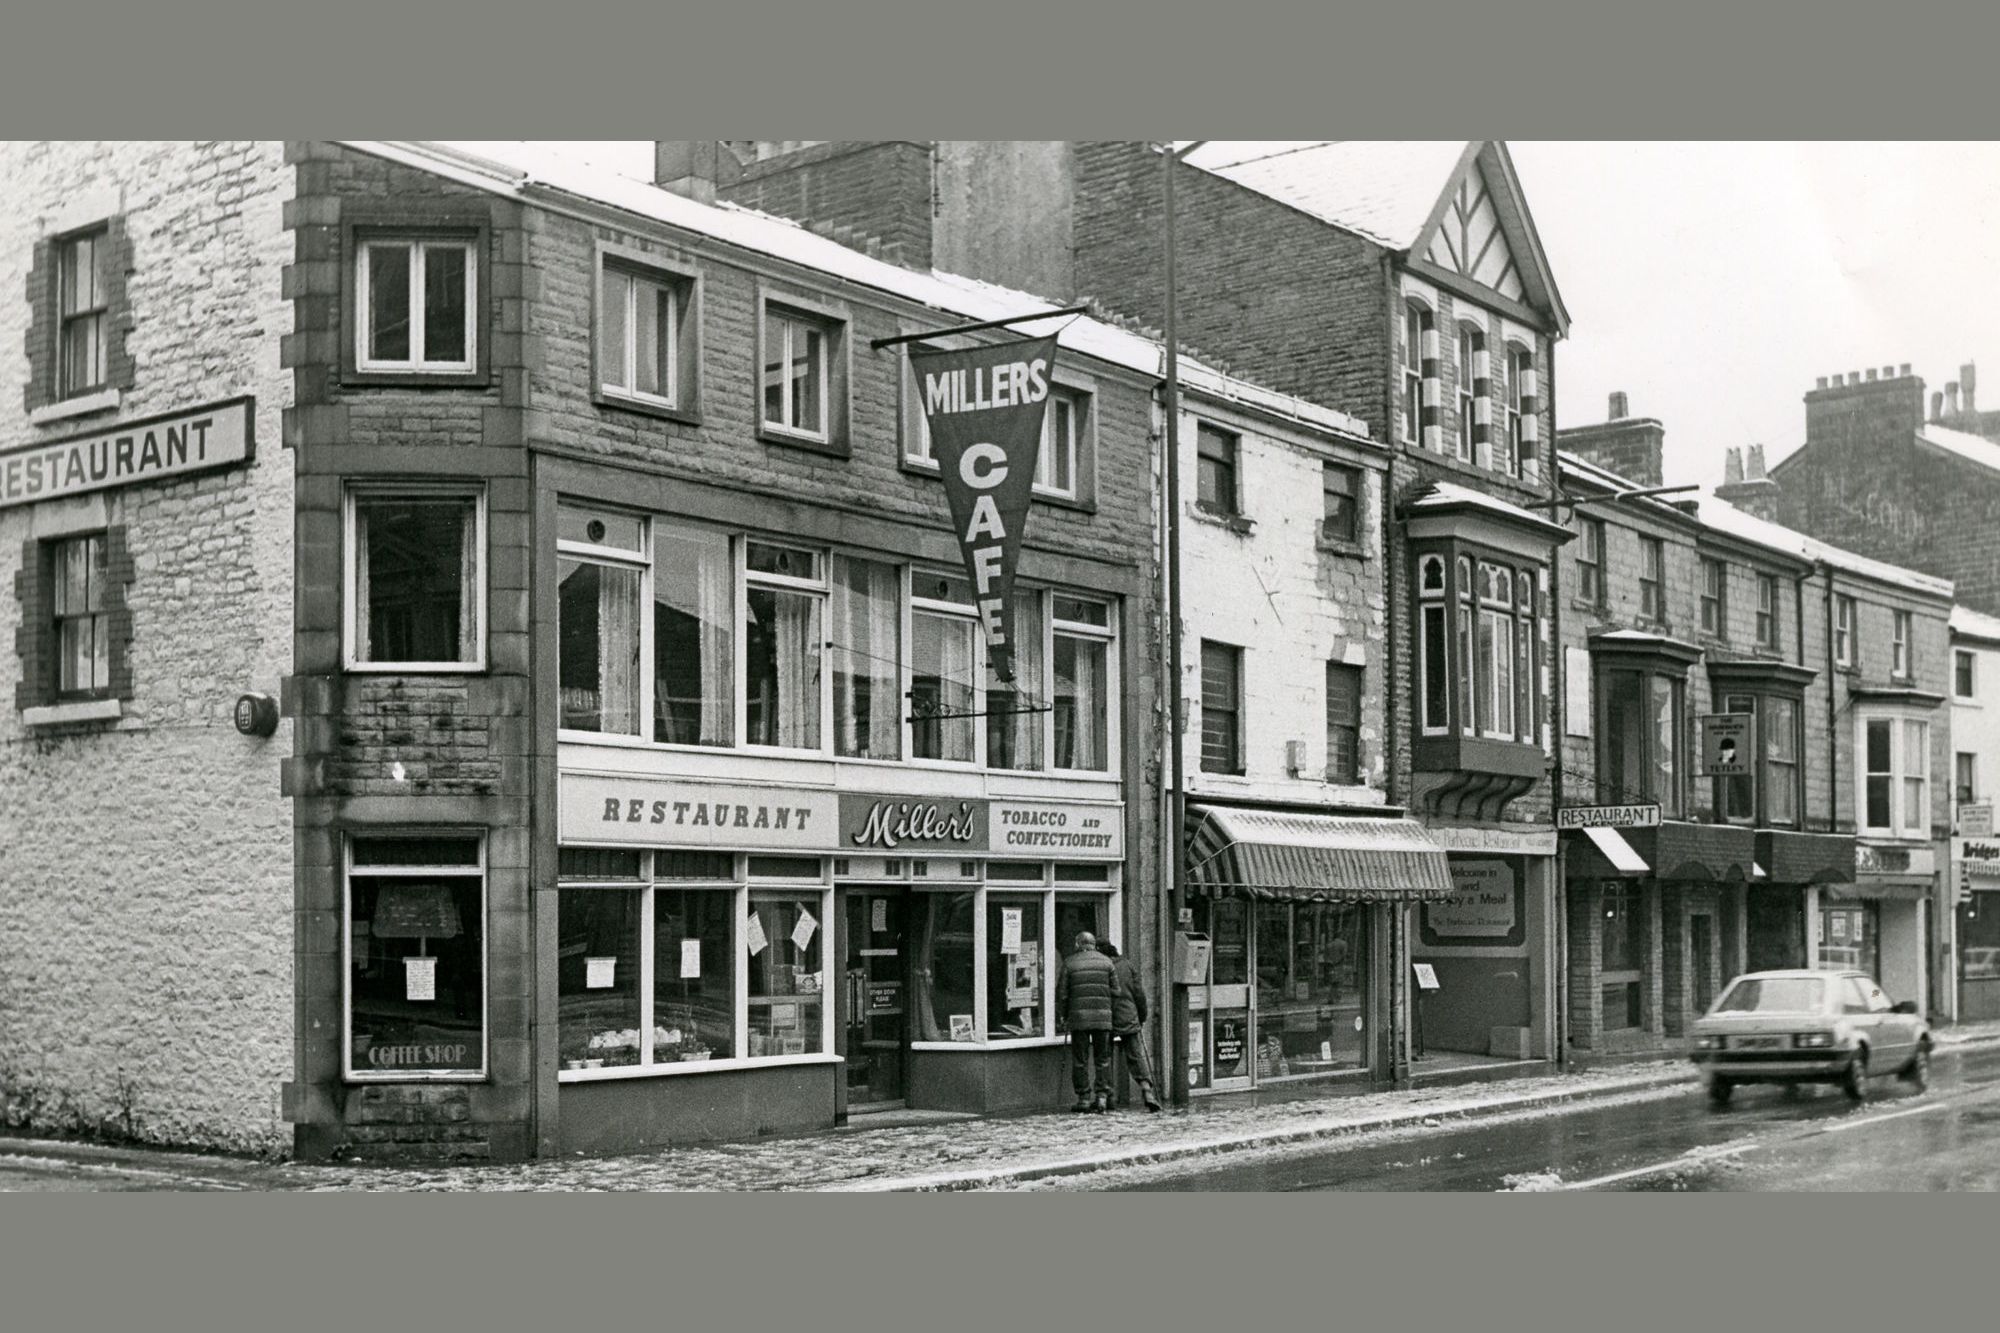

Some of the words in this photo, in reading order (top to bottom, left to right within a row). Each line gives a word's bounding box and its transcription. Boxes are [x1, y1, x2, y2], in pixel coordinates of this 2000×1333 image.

[926, 358, 1038, 415] MILLERS
[0, 418, 213, 500] ESTAURANT
[959, 442, 1008, 646] CAFE
[1710, 764, 1744, 772] TETLEY
[602, 798, 811, 831] RESTAURANT
[854, 801, 976, 848] Miller's
[1001, 809, 1067, 826] TOBACCO
[1082, 818, 1101, 828] AND
[1561, 807, 1656, 826] RESTAURANT
[1582, 819, 1635, 828] LICENSED
[1006, 830, 1112, 848] CONFECTIONERY
[1480, 892, 1507, 905] Meal
[368, 1046, 421, 1066] COFFEE
[424, 1044, 467, 1063] SHOP
